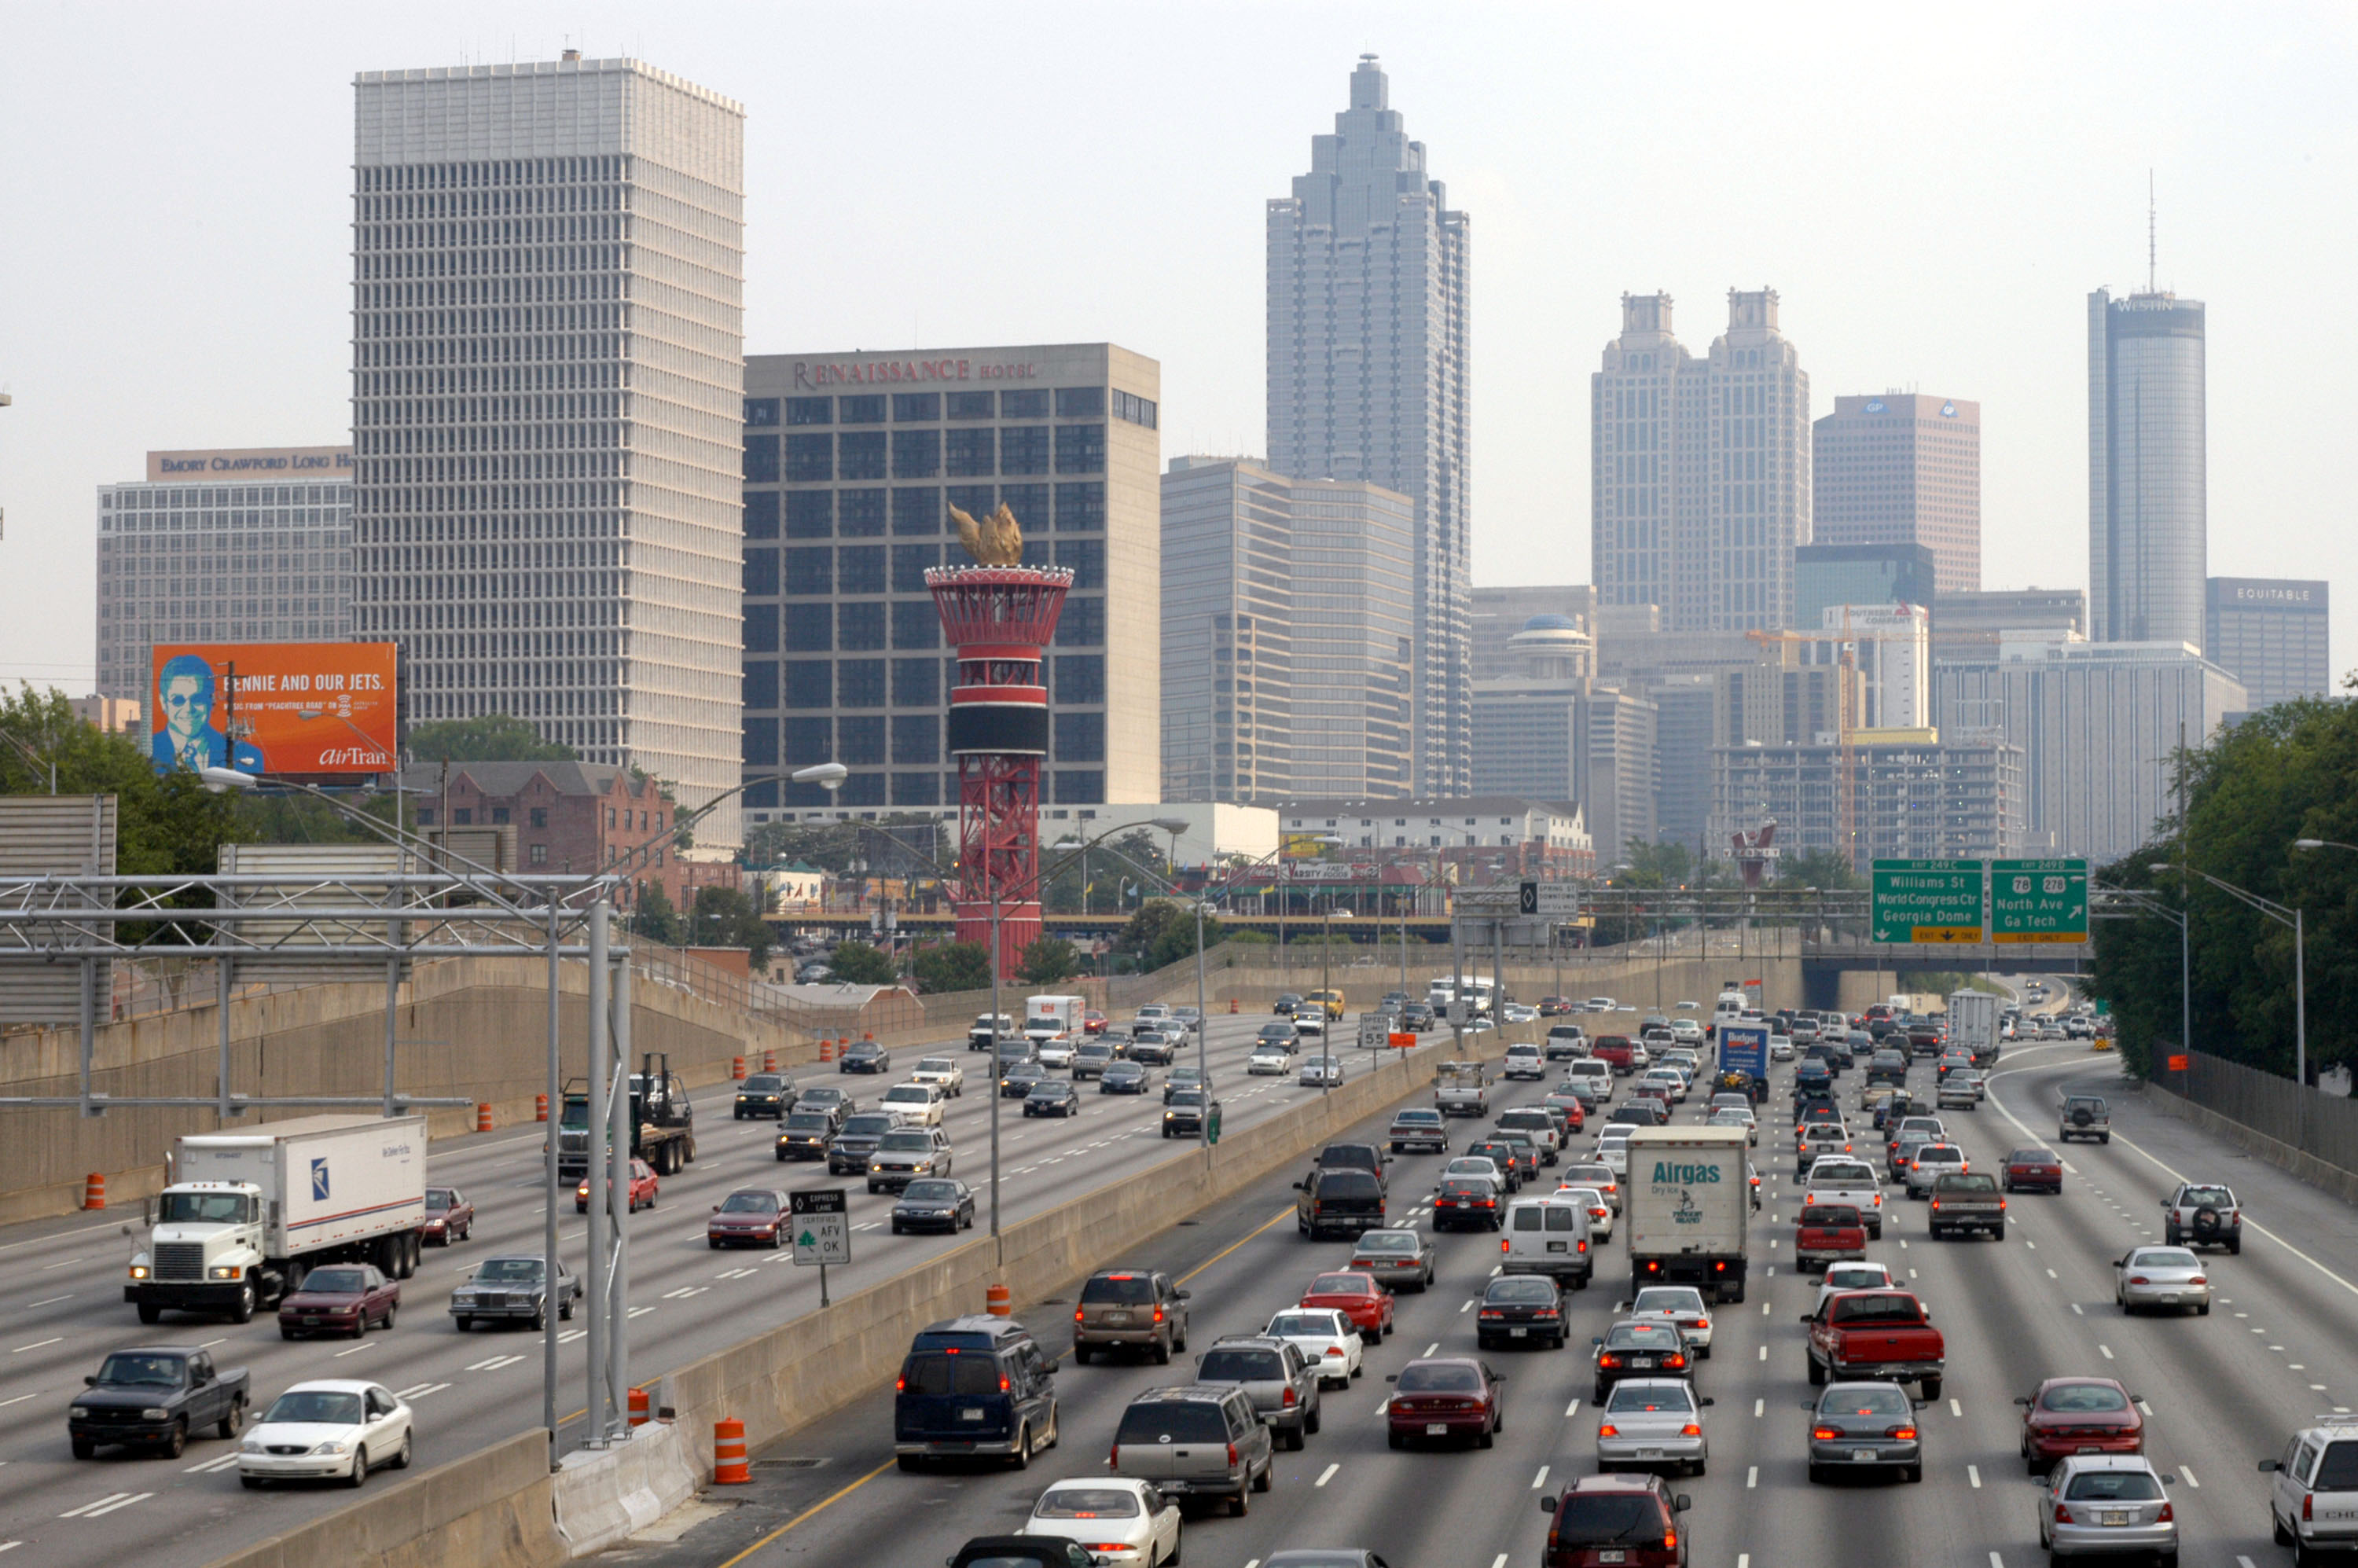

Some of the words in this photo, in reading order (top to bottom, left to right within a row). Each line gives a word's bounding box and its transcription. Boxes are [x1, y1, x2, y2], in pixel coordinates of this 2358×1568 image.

[794, 358, 971, 390] RENAISSANCE
[980, 363, 1036, 379] HOTEL
[1867, 402, 1883, 413] GP
[1944, 406, 1955, 414] GP
[160, 458, 207, 472] EMORY
[211, 456, 288, 471] CRAWFORD
[292, 454, 330, 468] LONG
[2237, 587, 2310, 601] EQUITABLE
[281, 674, 310, 692] AND
[315, 674, 344, 691] OUR
[349, 674, 385, 691] JETS.
[223, 702, 244, 711] MSIC
[1890, 876, 1945, 888] Williams
[1951, 876, 1965, 888] St
[2015, 879, 2029, 890] 78
[2045, 879, 2063, 890] 278
[1877, 893, 1907, 905] World
[1908, 893, 1959, 909] Congress
[1960, 893, 1978, 905] Ctr
[1997, 898, 2033, 910] North
[2039, 898, 2063, 910] Ave
[1883, 910, 1931, 924] Georgia
[1937, 910, 1972, 922] Dome
[2004, 915, 2021, 927] Ga
[2026, 915, 2056, 927] Tech
[1365, 1034, 1384, 1045] 55
[1728, 1032, 1758, 1045] Budget
[1652, 1162, 1721, 1185] Airgas
[1651, 1185, 1666, 1195] Dry
[1667, 1185, 1679, 1194] Ice
[810, 1194, 839, 1203] EXPRESS
[803, 1215, 837, 1224] CERTIFIED
[821, 1225, 840, 1237] AFV
[823, 1241, 839, 1252] OK
